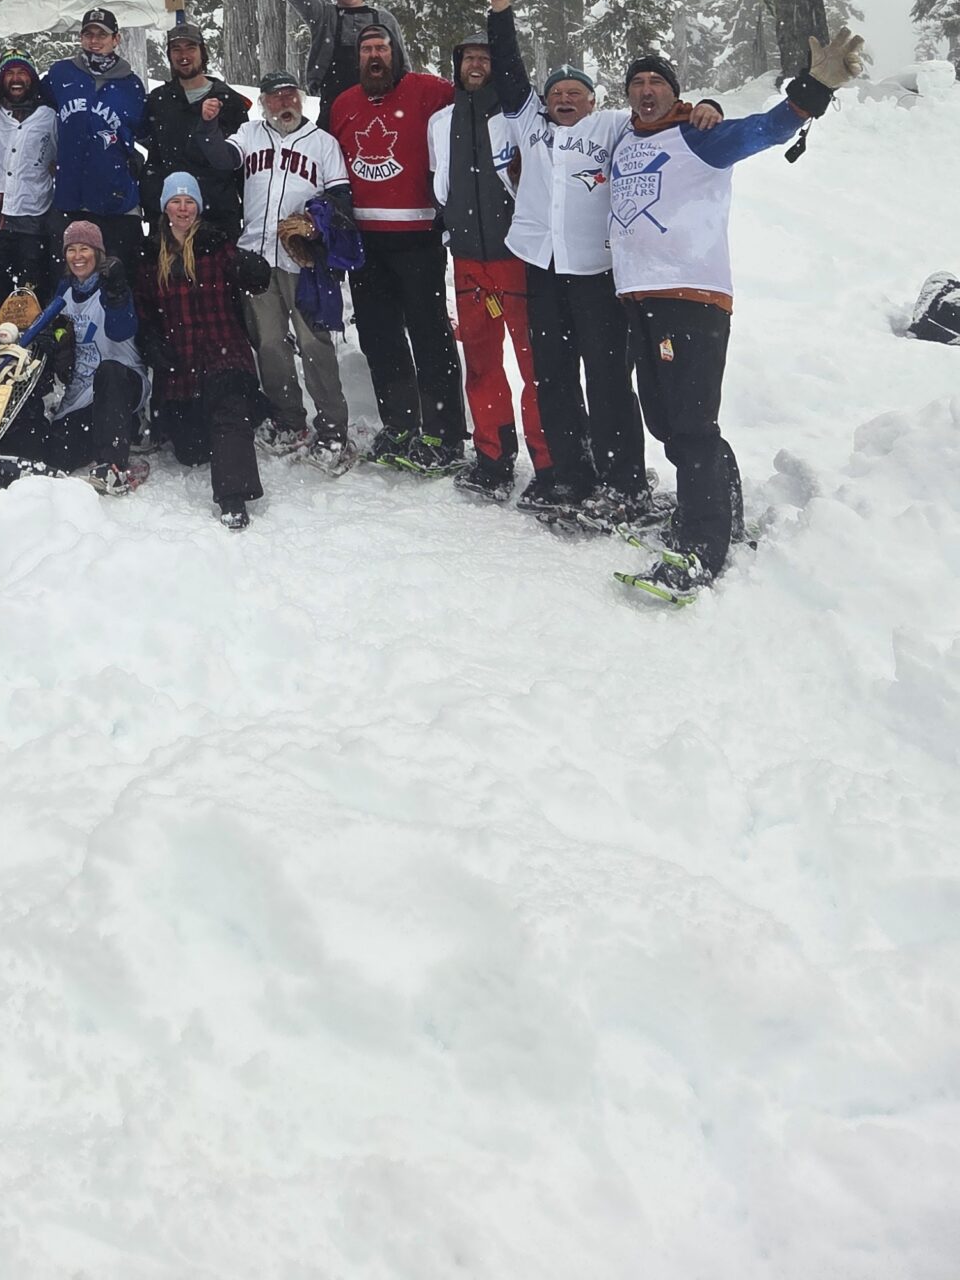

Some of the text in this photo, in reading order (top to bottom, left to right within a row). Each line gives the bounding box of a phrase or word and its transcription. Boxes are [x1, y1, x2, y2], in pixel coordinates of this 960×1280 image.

[60, 98, 121, 130] BLUE JAYS
[559, 137, 609, 163] JAYS
[353, 160, 401, 179] CANADA
[622, 161, 644, 172] 2016
[621, 189, 655, 200] YEARS
